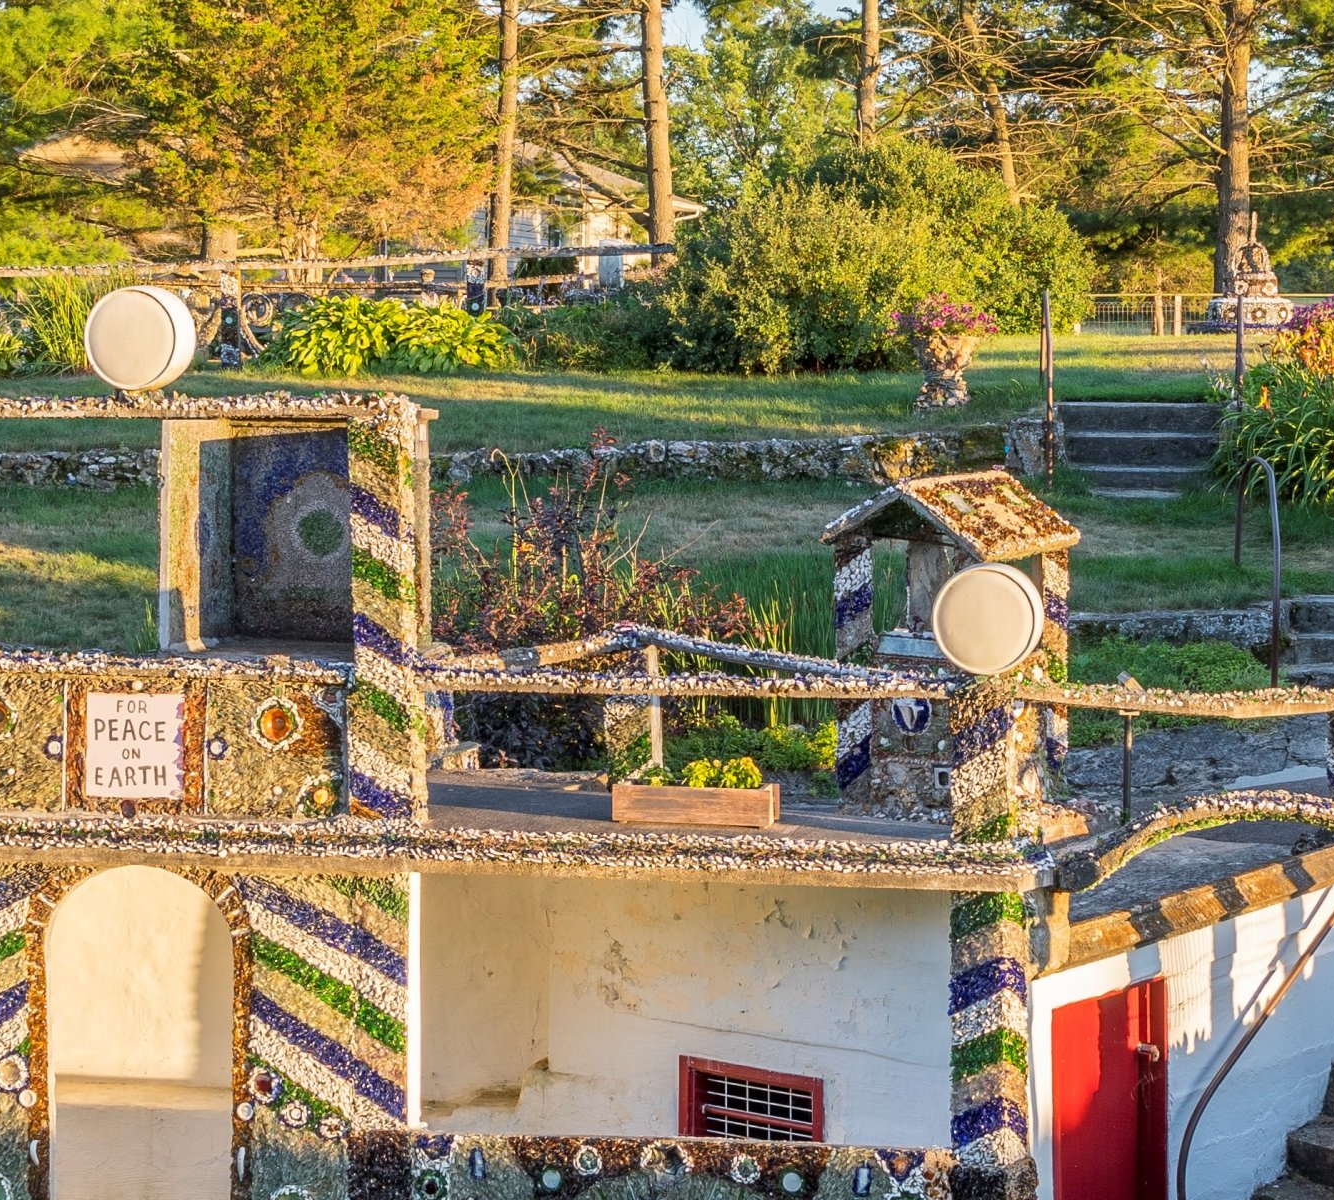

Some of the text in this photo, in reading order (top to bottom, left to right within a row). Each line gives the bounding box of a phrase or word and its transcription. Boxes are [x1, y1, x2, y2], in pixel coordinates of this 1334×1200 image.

[116, 700, 147, 714] FOR
[94, 718, 167, 742] PEACE
[122, 748, 141, 760] ON
[94, 765, 167, 788] EARTH
